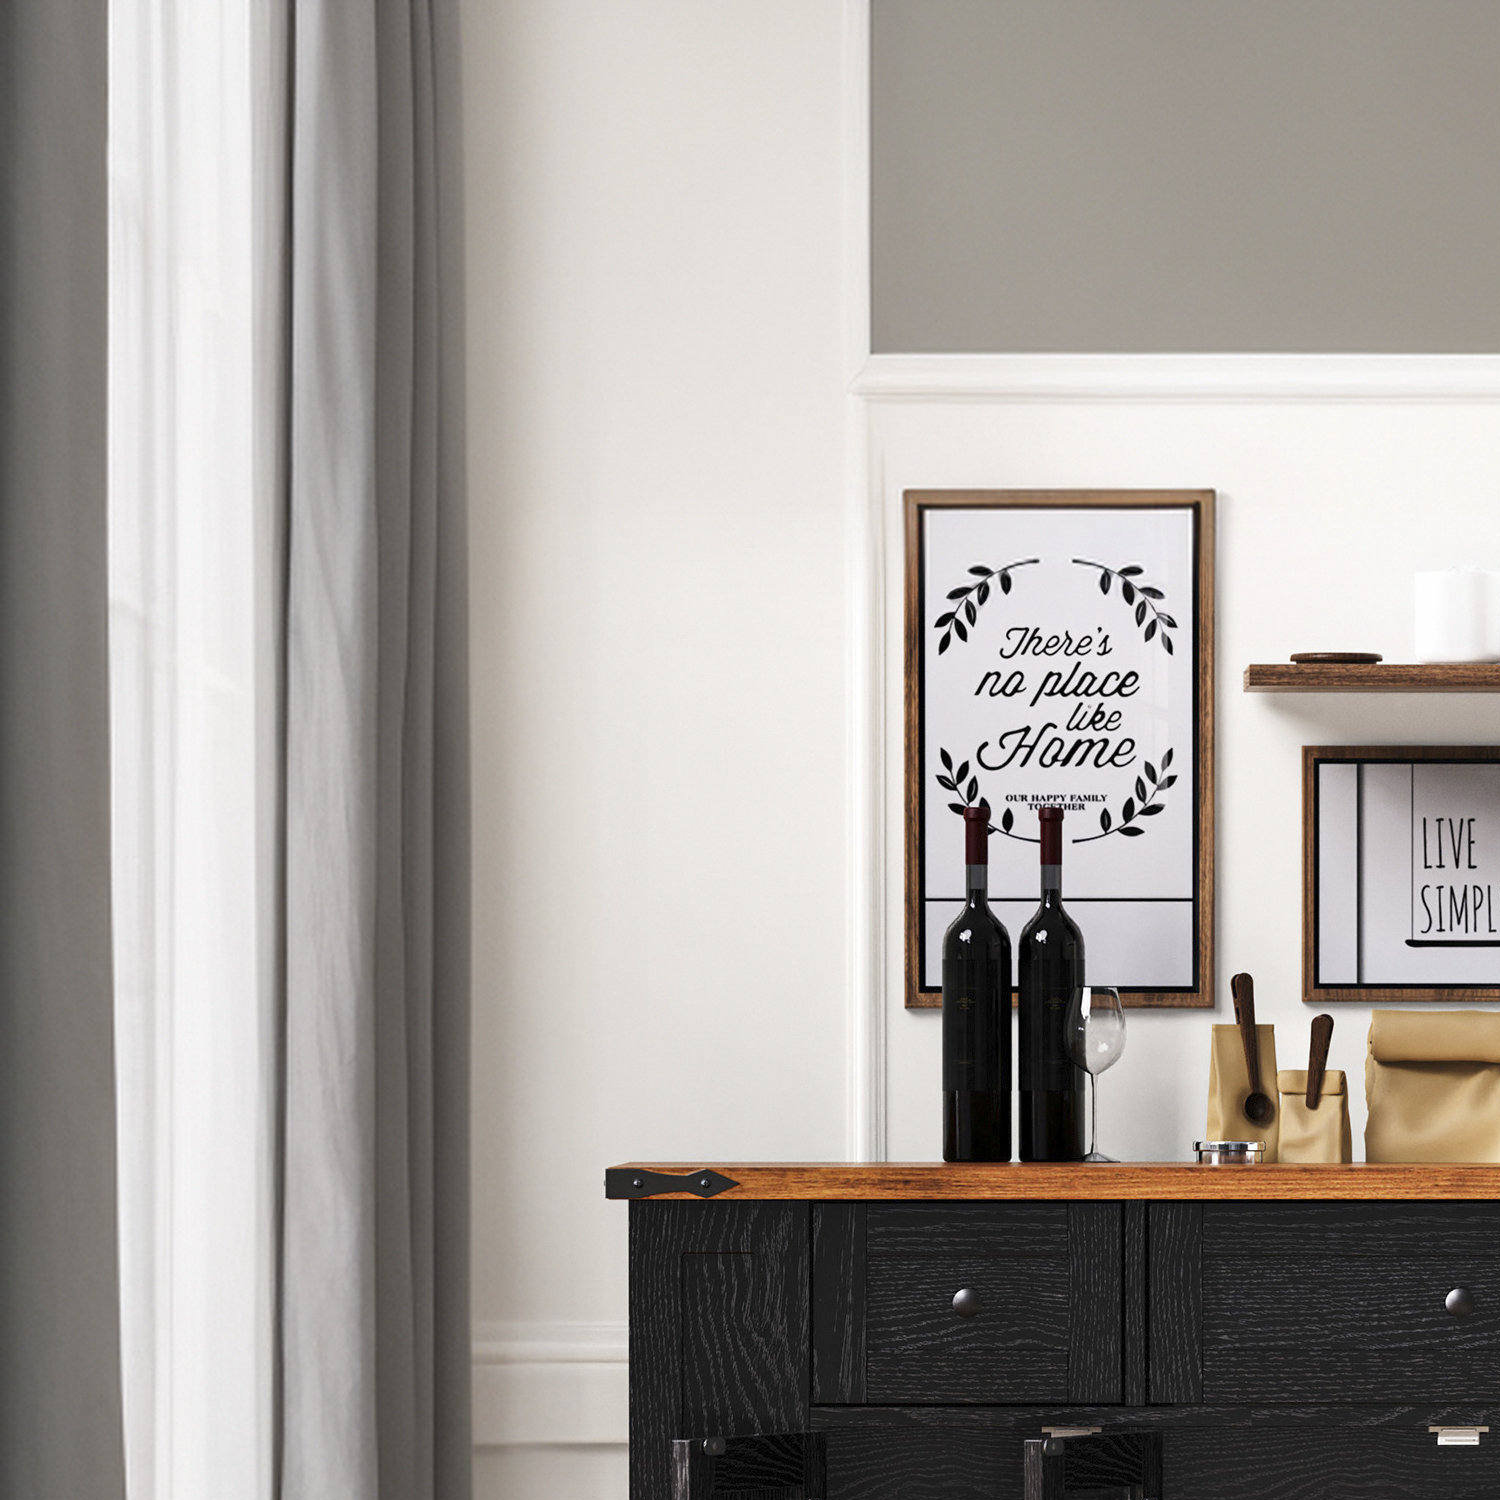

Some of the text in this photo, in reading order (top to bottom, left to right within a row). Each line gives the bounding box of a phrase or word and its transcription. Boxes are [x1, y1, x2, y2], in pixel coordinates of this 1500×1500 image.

[1000, 627, 1112, 659] There's
[975, 661, 1140, 708] no place
[1066, 702, 1122, 732] like
[976, 722, 1137, 771] Home
[1005, 794, 1108, 803] OUR HAPPY FAMILY
[1422, 817, 1477, 869] LIVE
